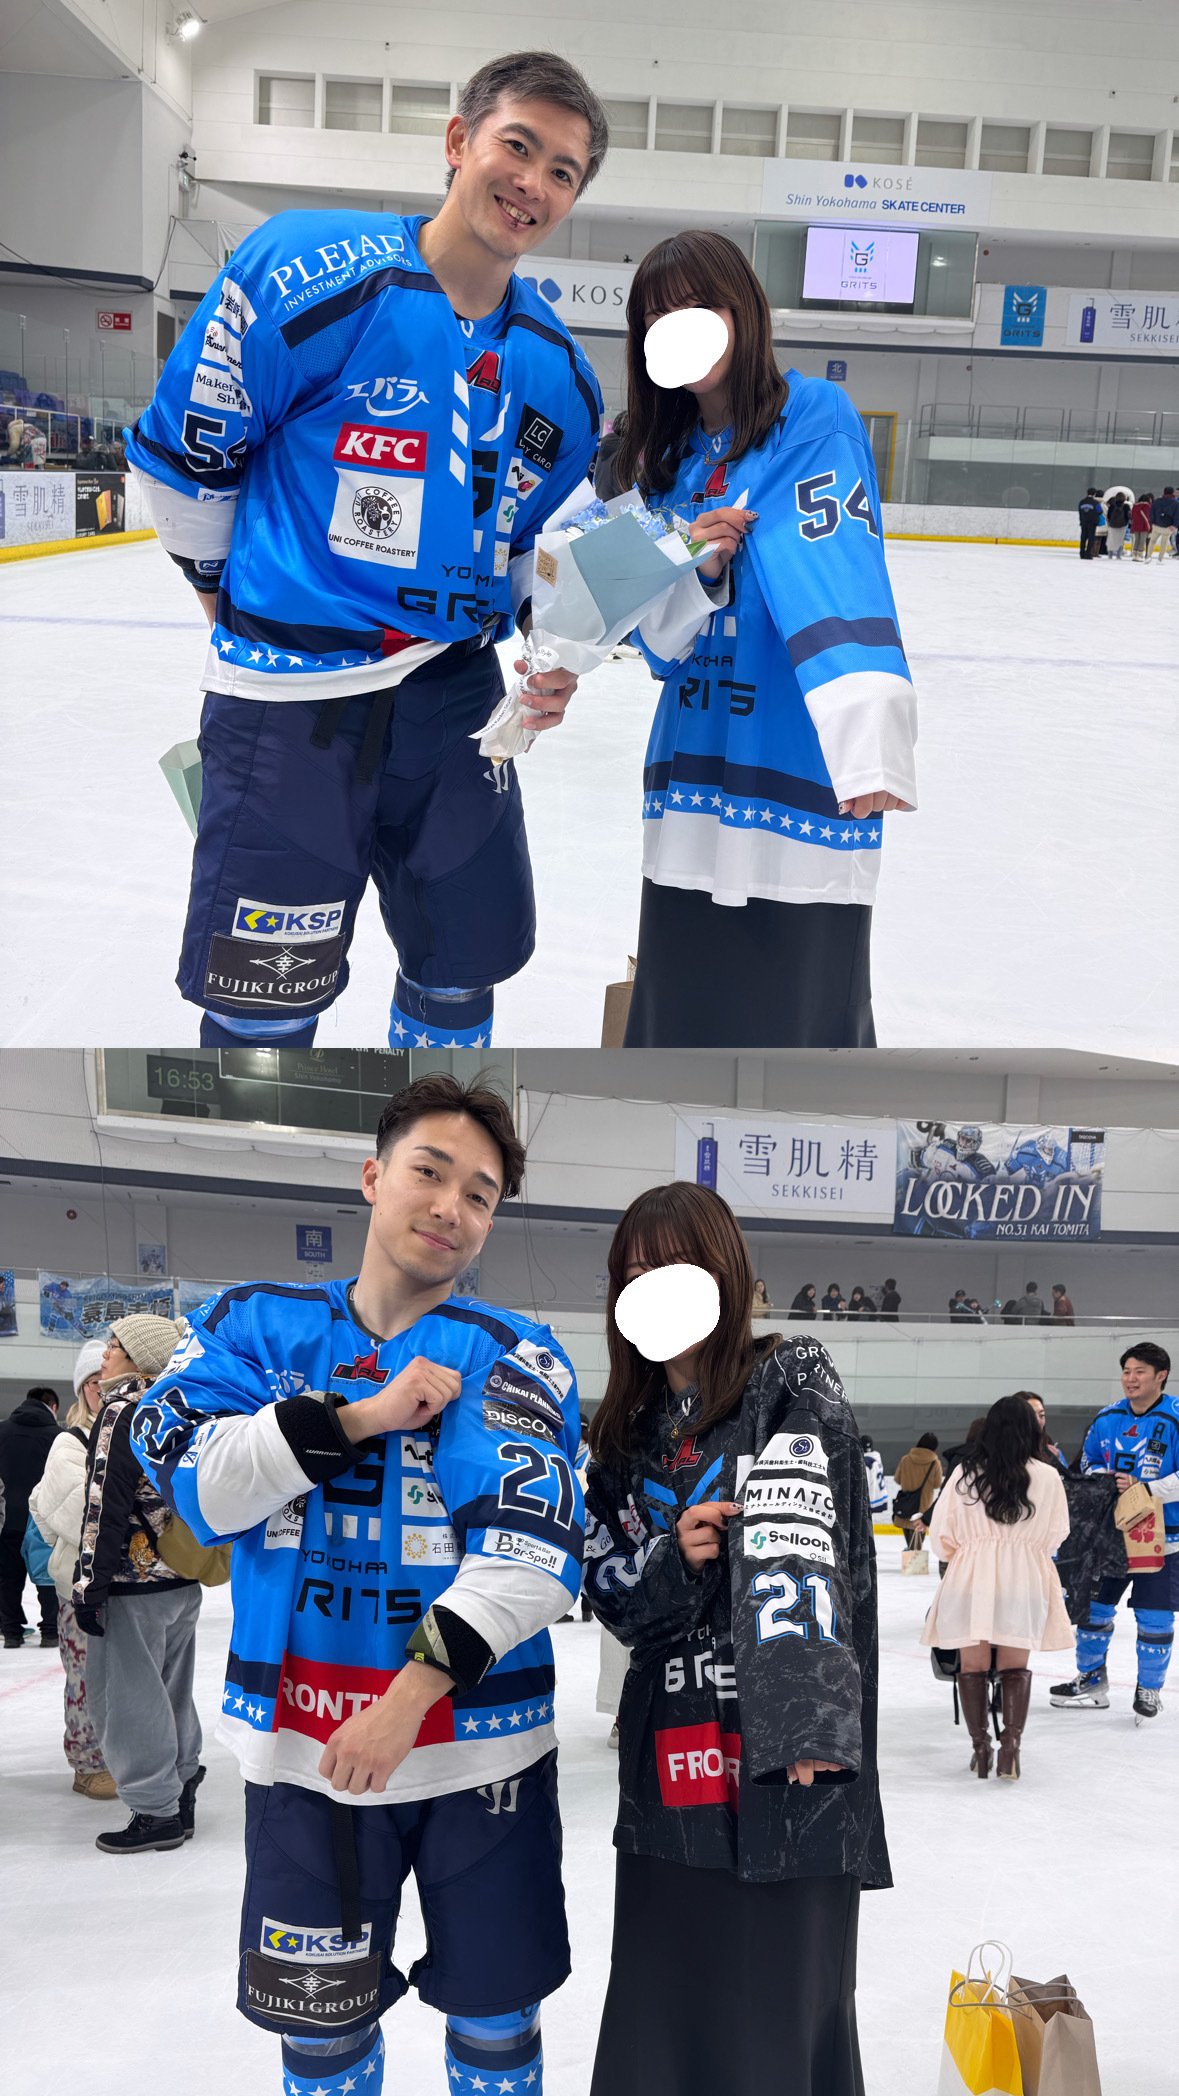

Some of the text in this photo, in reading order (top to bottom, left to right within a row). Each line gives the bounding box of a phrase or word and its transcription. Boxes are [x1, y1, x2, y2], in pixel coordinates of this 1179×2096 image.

[872, 176, 913, 191] KOSÉ
[785, 193, 966, 214] Shin Yokohama SKATE CENTER
[283, 267, 356, 312] INVESTMENT
[572, 283, 625, 306] KOS
[840, 280, 878, 290] GRITS
[1109, 303, 1179, 330] 雪肌
[1003, 329, 1041, 338] GRITS
[344, 376, 422, 406] エバラ
[340, 430, 420, 464] KFC
[13, 483, 66, 517] 雪肌精
[365, 488, 400, 515] COFFEE
[795, 469, 880, 543] 54
[354, 511, 398, 537] ROASTERY
[328, 533, 417, 557] UNI COFFEE ROASTERY
[285, 909, 342, 931] KSP
[207, 970, 338, 994] FUJIKI GROUP
[154, 1066, 216, 1092] 16:53
[738, 1133, 879, 1182] 雪肌精
[771, 1183, 843, 1201] SEKKISEI
[901, 1177, 1097, 1222] LOCKED IN
[304, 1229, 323, 1248] 南
[996, 1223, 1089, 1236] NO.31 KAI TOMITA
[303, 1250, 326, 1259] SOUTH
[501, 1381, 529, 1398] CHIKAI
[485, 1410, 549, 1434] DISCO
[1152, 1422, 1166, 1441] A
[497, 1441, 576, 1531] 21
[768, 1530, 830, 1552] Selloop
[296, 1577, 423, 1625] RITS
[751, 1570, 842, 1646] 21
[282, 1677, 382, 1721] RONT
[248, 1984, 378, 2014] FUJIKI GROUP
